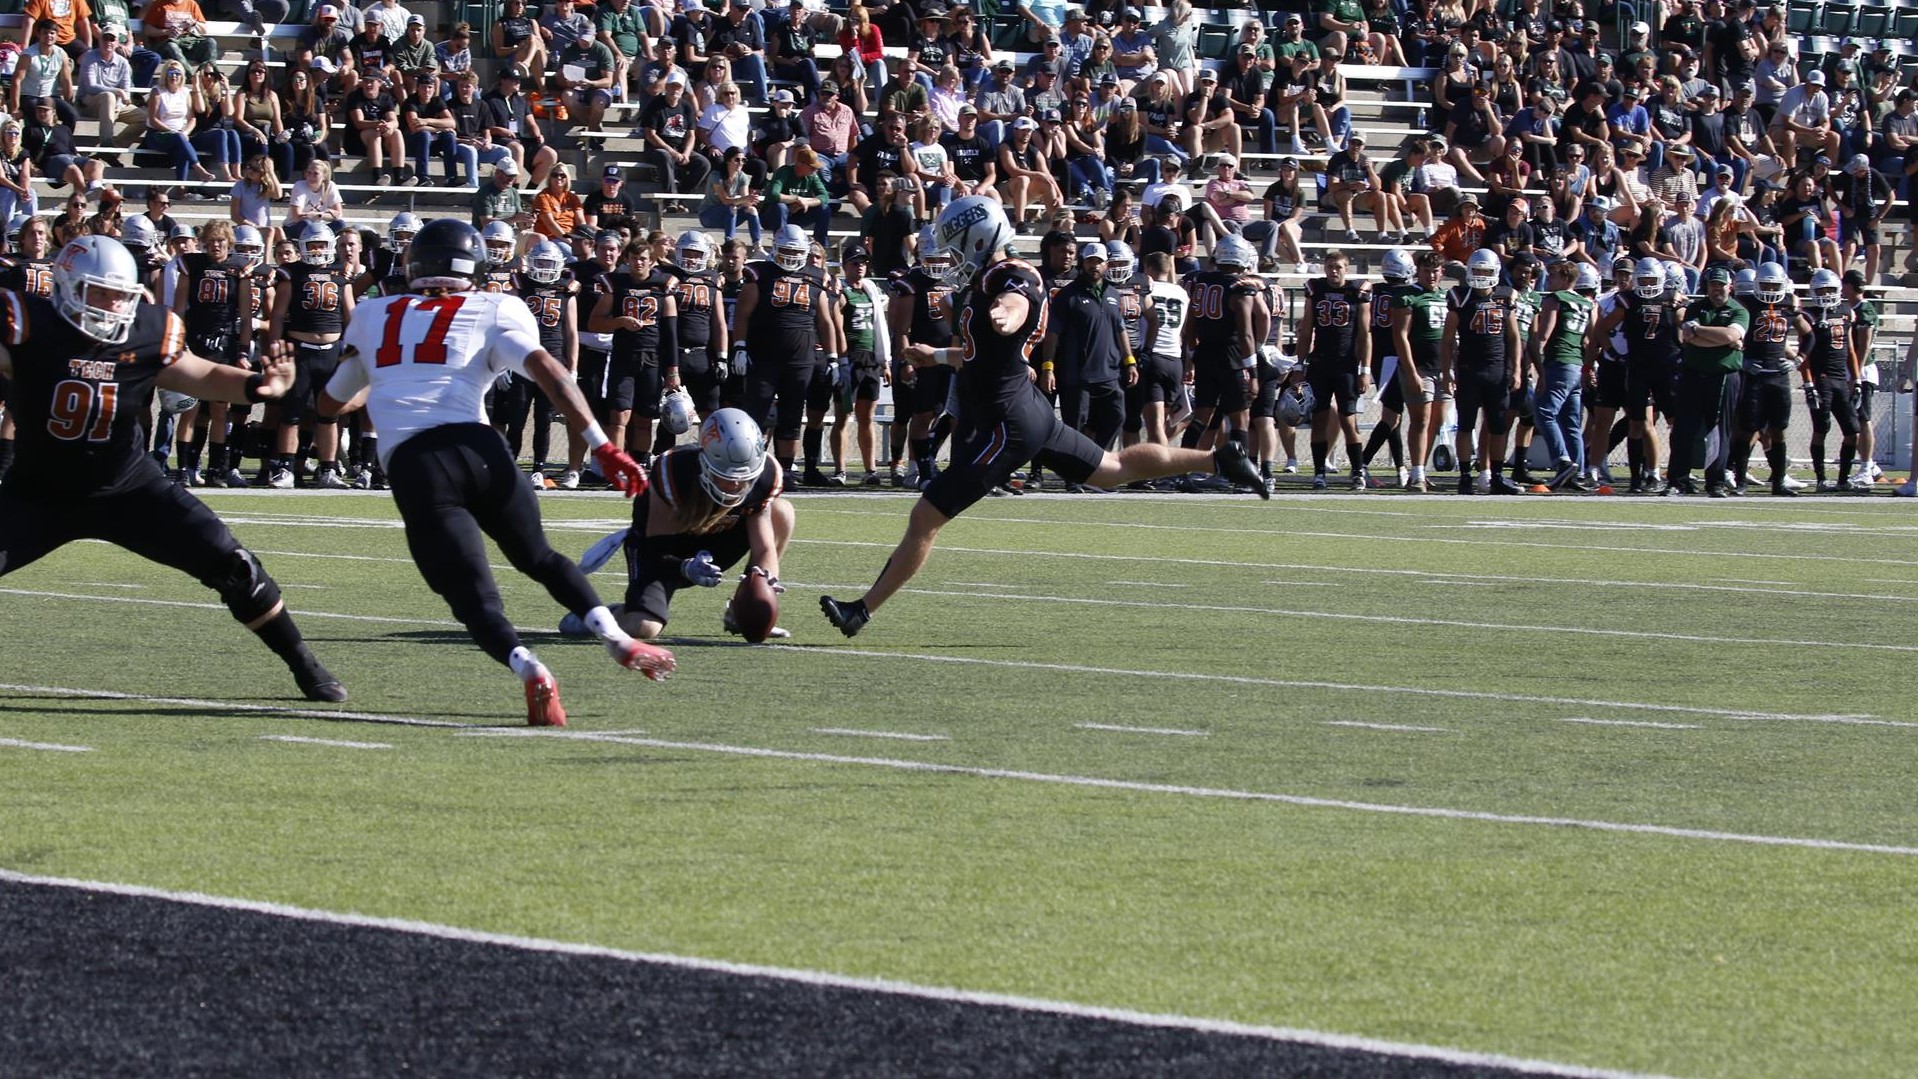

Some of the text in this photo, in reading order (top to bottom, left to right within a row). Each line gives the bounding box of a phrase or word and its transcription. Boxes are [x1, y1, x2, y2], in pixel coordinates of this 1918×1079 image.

[941, 203, 988, 237] DIGGERS
[26, 268, 54, 298] 16
[198, 278, 228, 303] 81
[302, 282, 339, 311] 36
[771, 282, 810, 312] 94
[525, 296, 561, 327] 25
[623, 296, 658, 326] 82
[678, 284, 710, 312] 78
[1316, 300, 1350, 327] 33
[1470, 309, 1504, 335] 45
[1644, 313, 1660, 339] 7
[376, 296, 467, 368] 17
[1753, 317, 1788, 343] 20
[68, 359, 117, 380] TECH
[47, 380, 119, 442] 91
